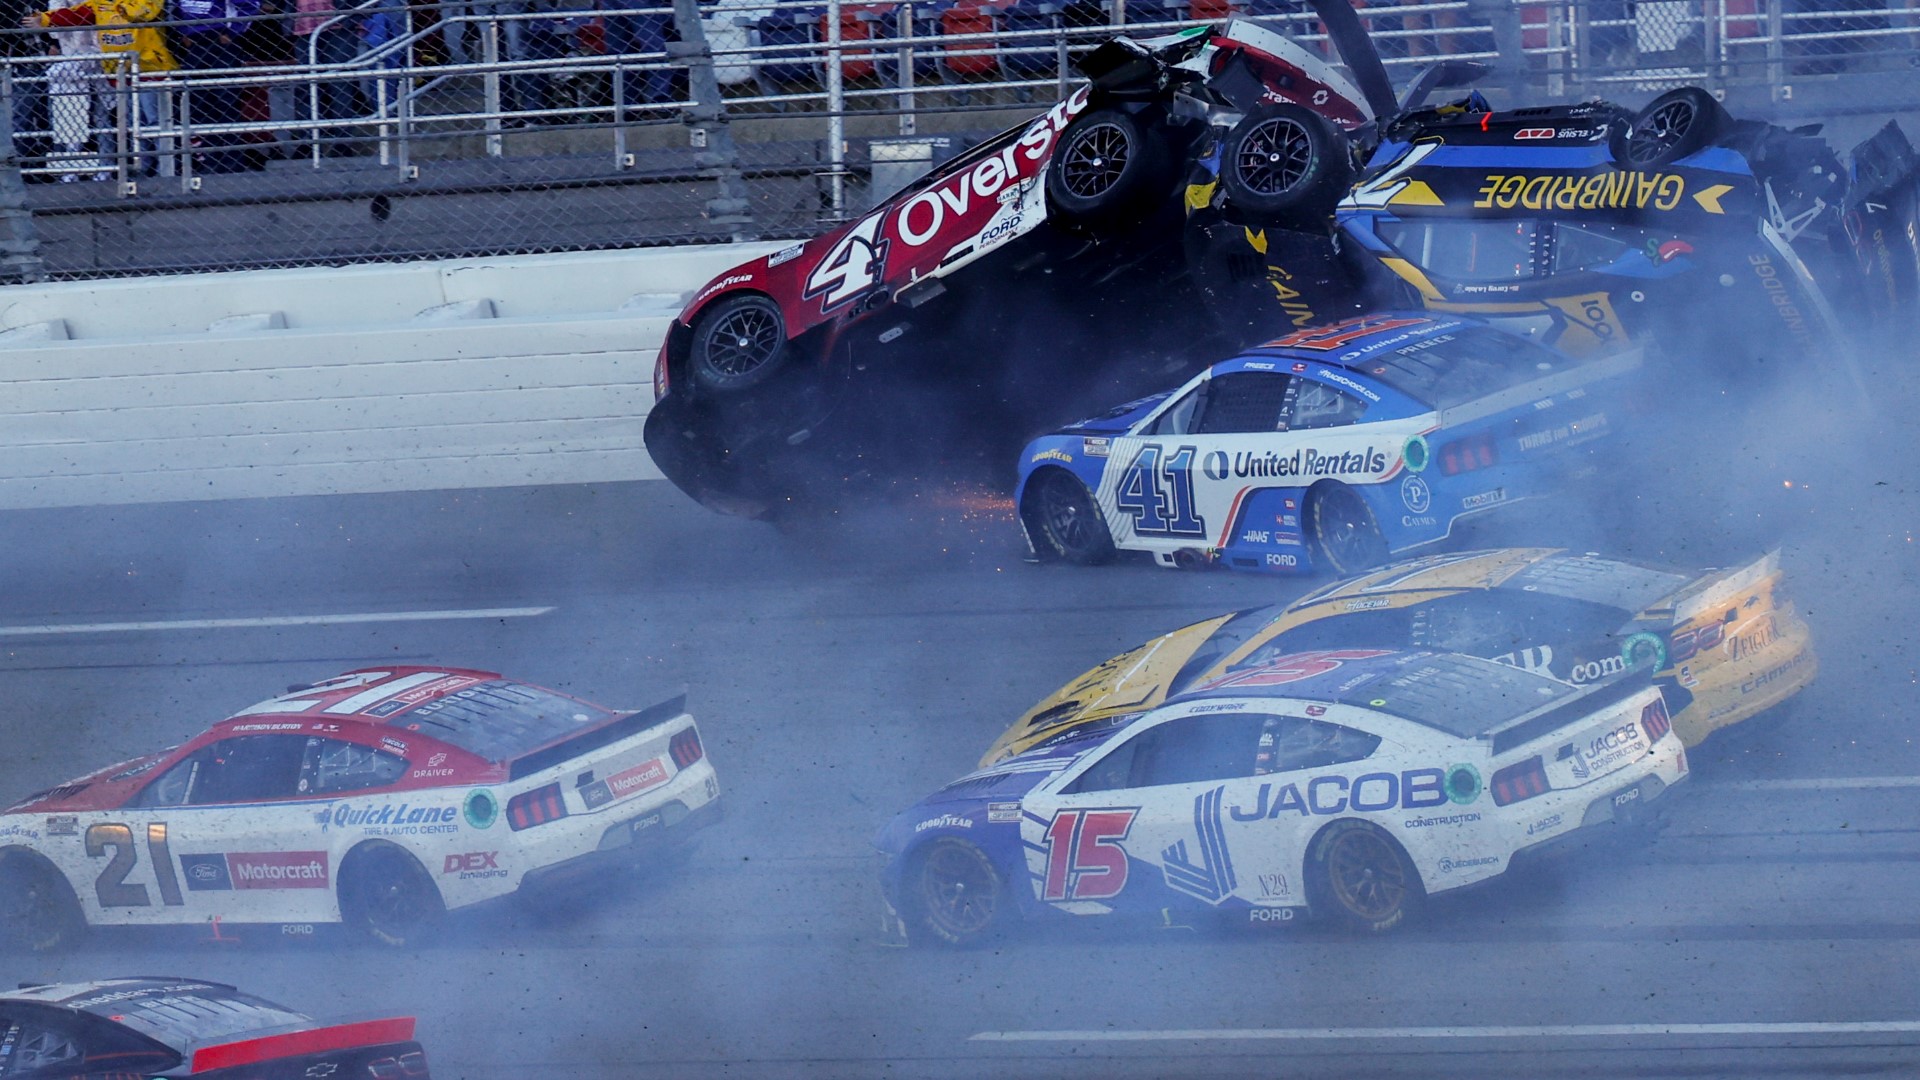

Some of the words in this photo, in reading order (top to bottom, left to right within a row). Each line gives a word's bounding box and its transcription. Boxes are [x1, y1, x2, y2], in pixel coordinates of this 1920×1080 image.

[1474, 172, 1685, 210] GAINBRIDGE
[980, 215, 1021, 244] FORD
[803, 206, 890, 313] 4
[698, 273, 753, 302] GOODYEAR
[1361, 334, 1409, 353] United
[1396, 334, 1456, 356] PREECE
[1243, 362, 1276, 370] PREECE
[1032, 448, 1073, 463] GOODYEAR
[1234, 449, 1300, 478] United
[1303, 447, 1385, 476] Rentals
[1116, 443, 1207, 540] 41
[1410, 486, 1421, 503] P
[1243, 530, 1270, 543] HAAS
[1266, 553, 1297, 567] FORD
[1729, 616, 1783, 662] ZEIGLER
[1586, 722, 1639, 759] JACOB
[1590, 740, 1645, 771] CONSTRUCTION
[413, 768, 455, 778] DRAIVER
[613, 765, 661, 792] Motorcraft
[1230, 768, 1448, 822] JACOB
[1615, 788, 1639, 806] FORD
[364, 827, 383, 836] TIRE
[390, 826, 418, 835] AUTO
[419, 825, 459, 834] CENTER
[915, 814, 974, 832] GOODYEAR
[1404, 811, 1482, 829] CONSTRUCTION
[85, 821, 185, 908] 21
[443, 850, 499, 874] DEX
[1041, 807, 1142, 901] 15
[237, 860, 325, 881] Motorcraft
[459, 868, 508, 880] Imaging
[1250, 907, 1294, 922] FORD
[281, 924, 314, 935] FORD
